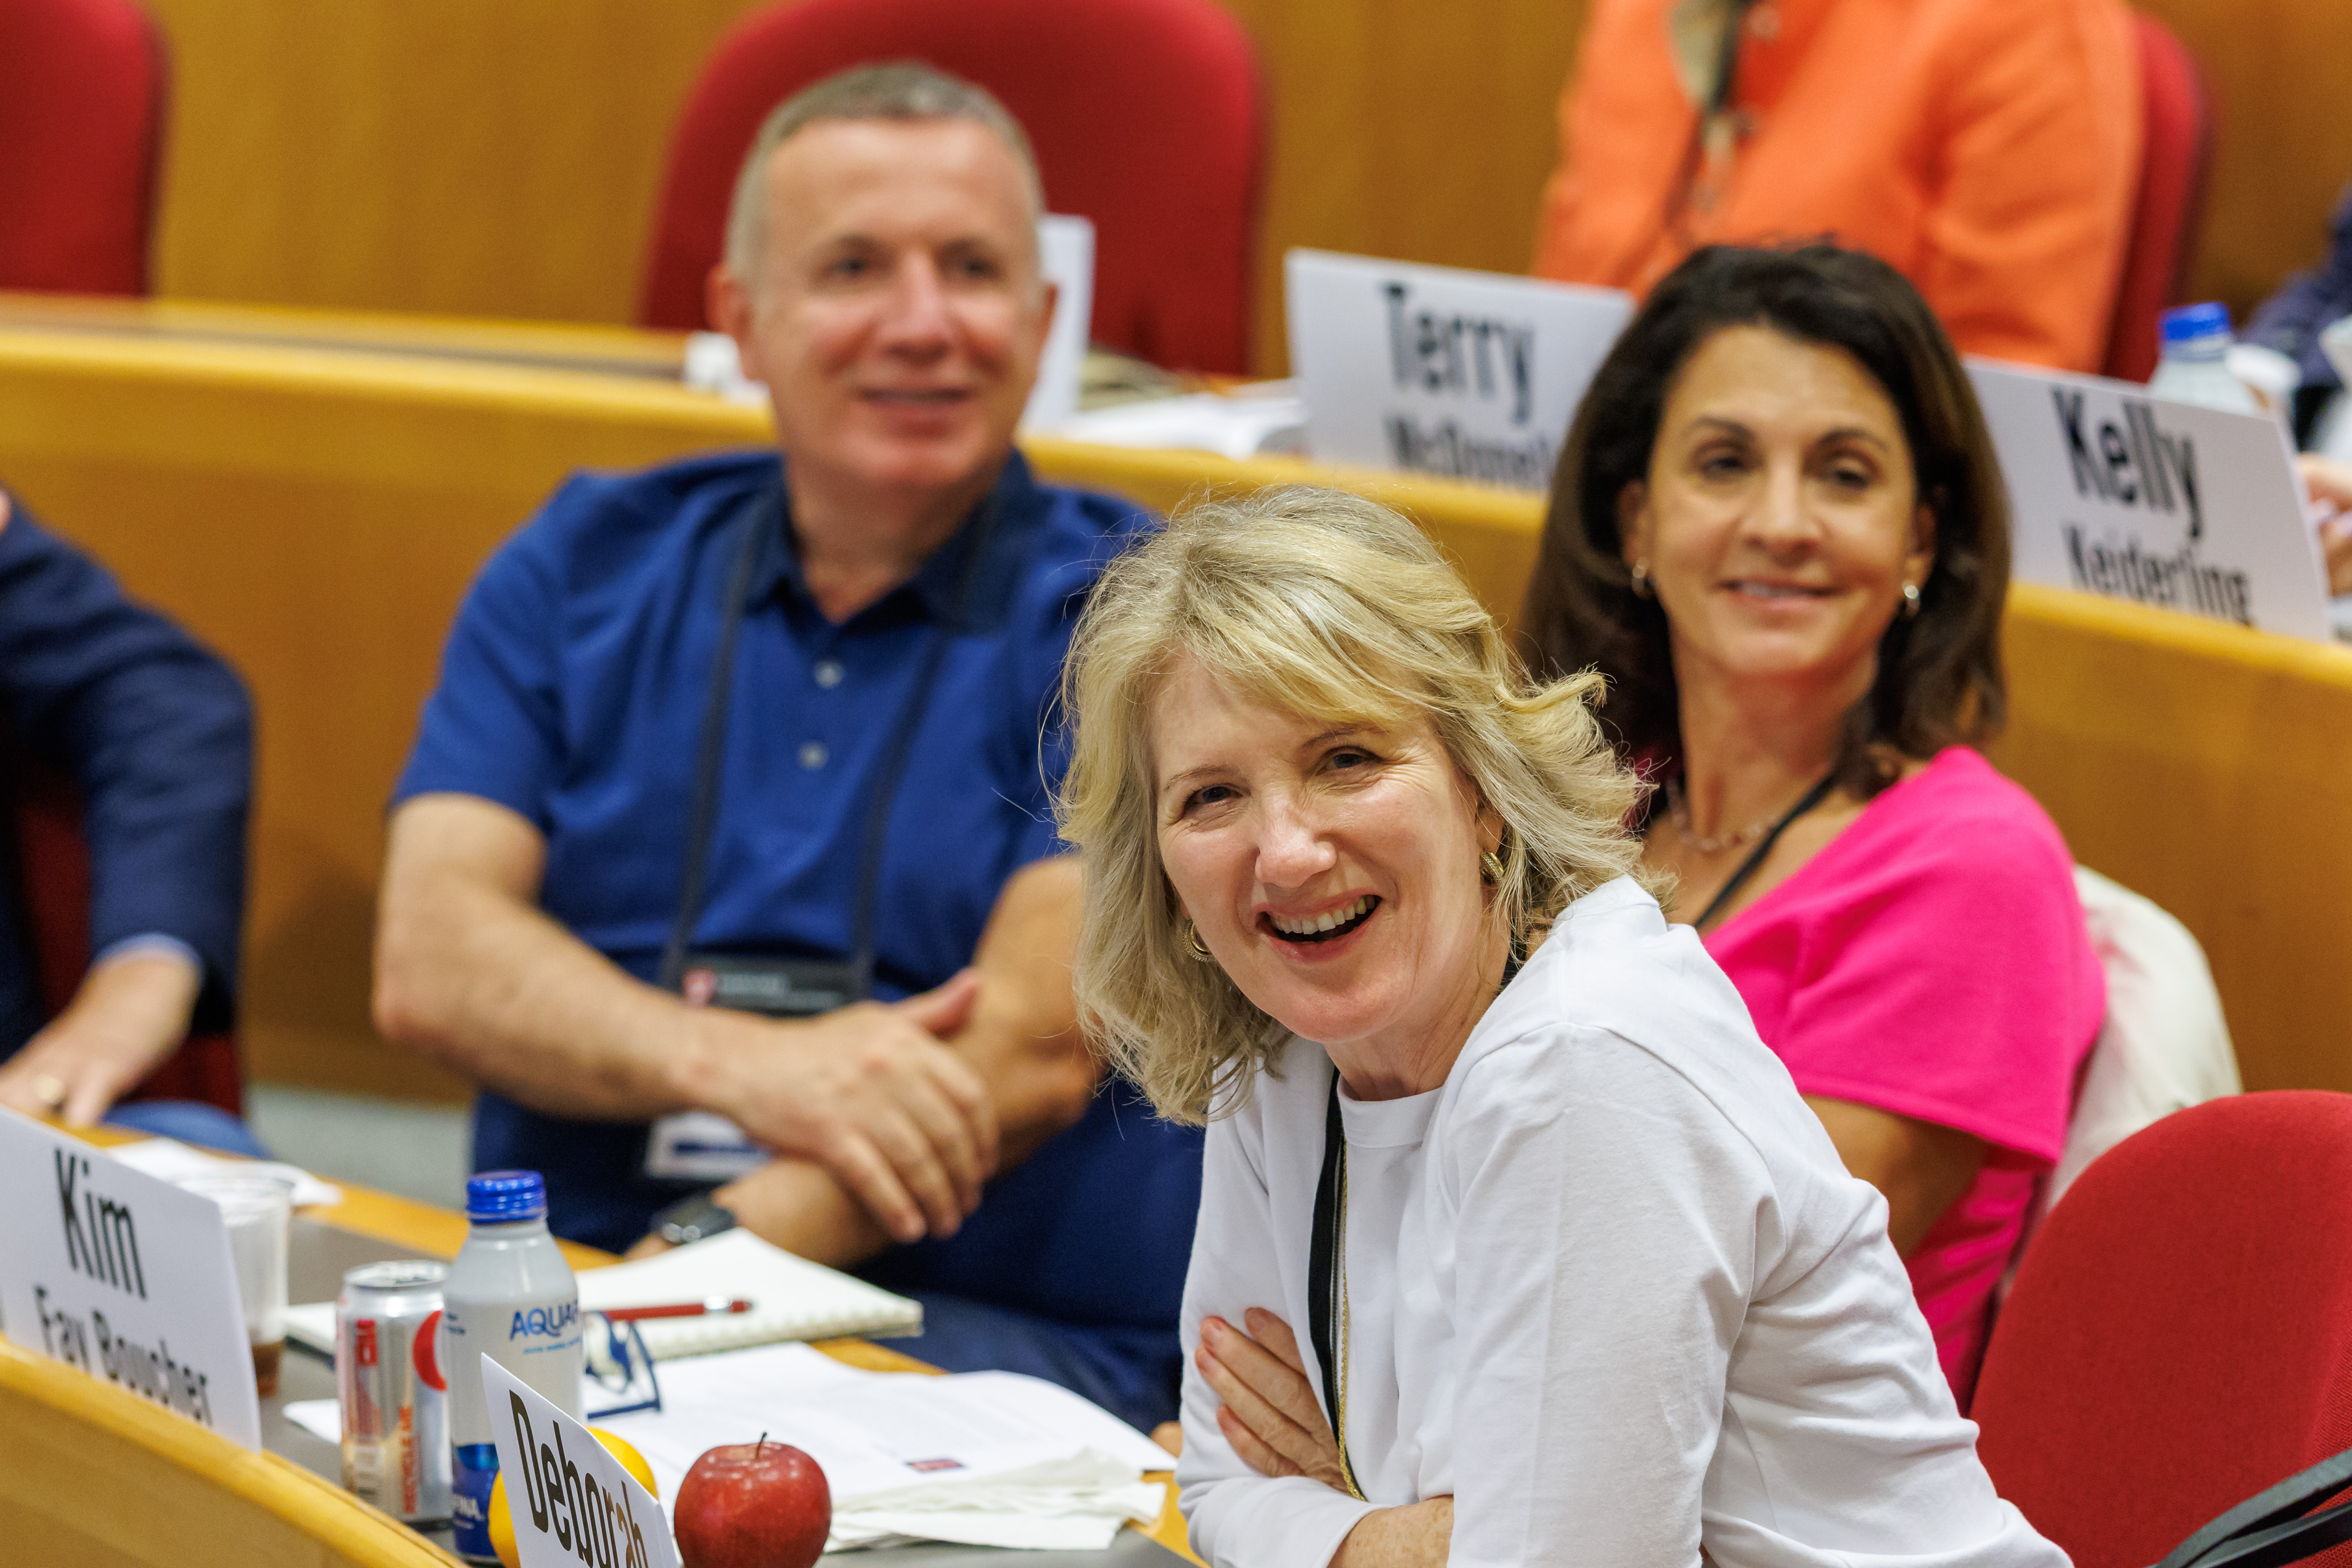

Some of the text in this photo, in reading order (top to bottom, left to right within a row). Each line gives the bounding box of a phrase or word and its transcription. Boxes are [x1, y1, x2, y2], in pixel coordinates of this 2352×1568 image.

[1379, 281, 1535, 424] Terry
[2052, 387, 2205, 540] Kelly
[55, 1146, 147, 1300] Kim
[92, 1308, 213, 1427] Boucher
[509, 1389, 649, 1568] Deborah
